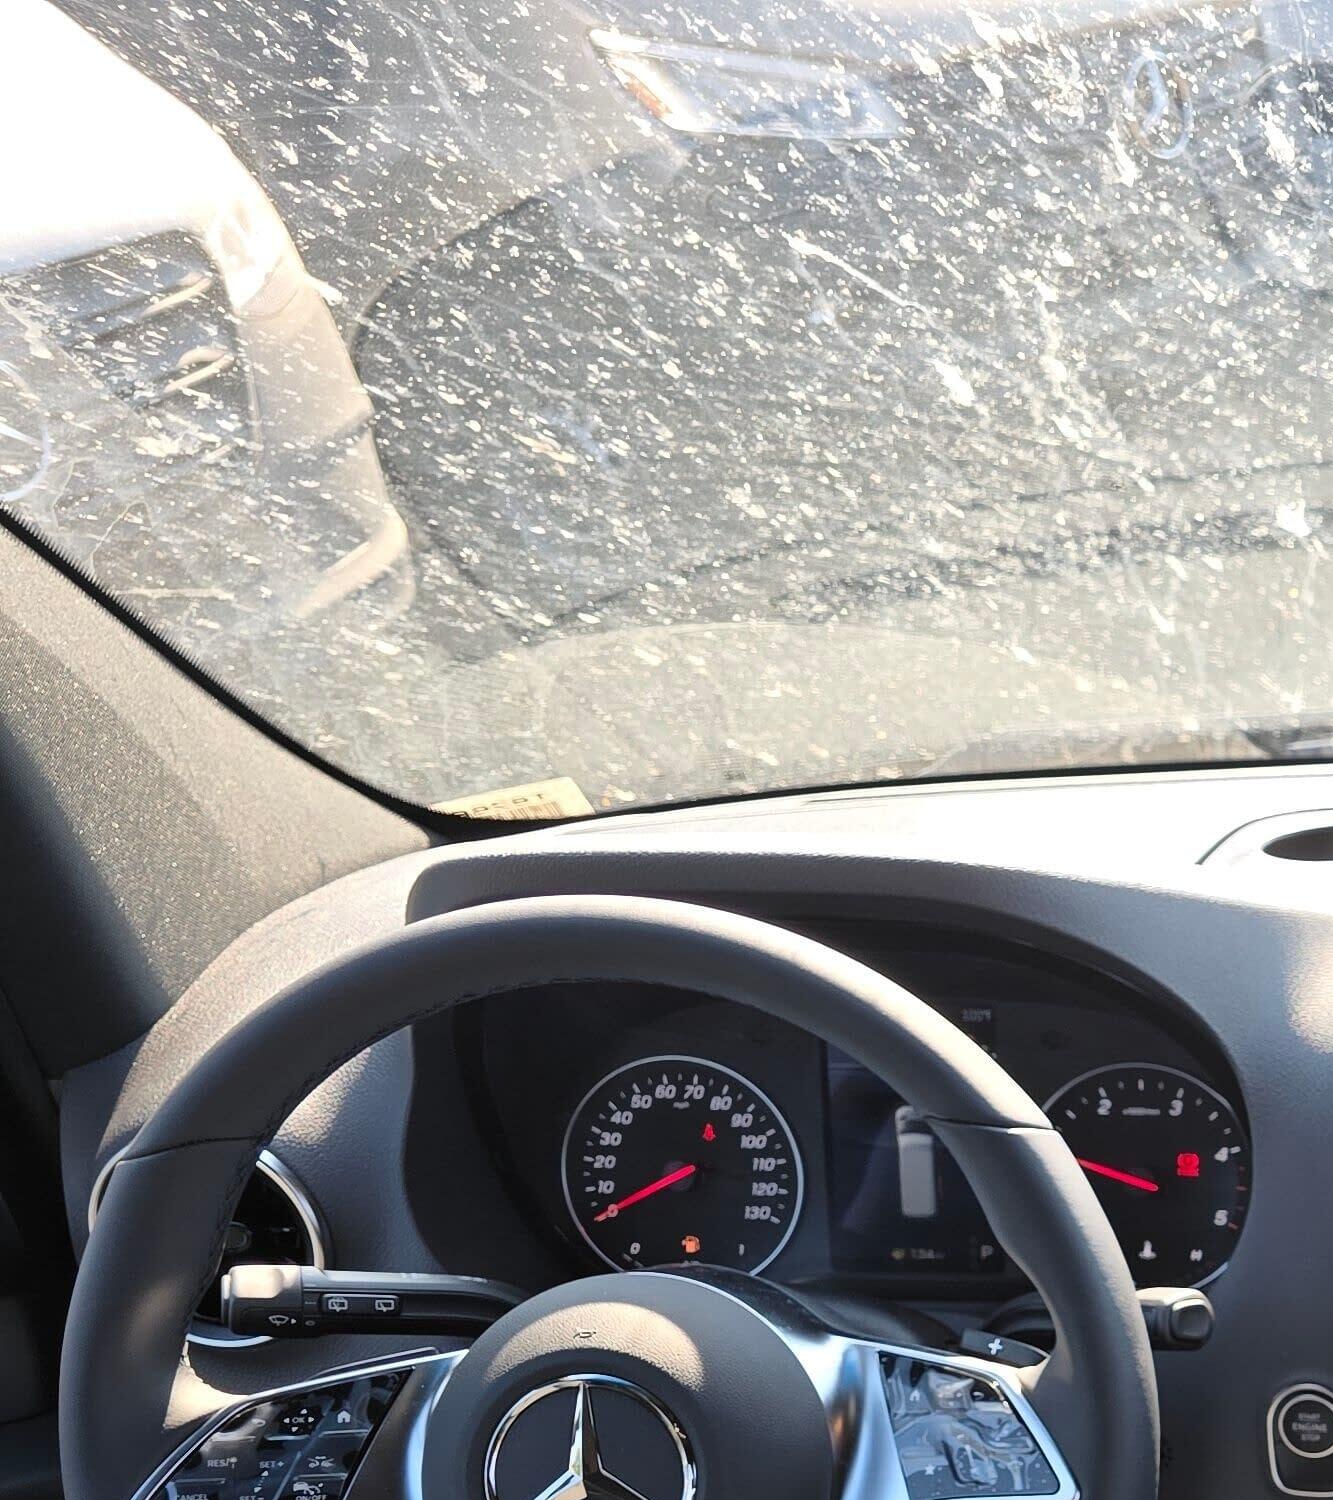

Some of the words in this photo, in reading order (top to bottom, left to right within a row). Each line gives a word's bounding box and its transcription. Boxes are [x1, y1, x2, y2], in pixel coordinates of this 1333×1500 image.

[655, 1084, 677, 1099] 60
[684, 1084, 705, 1099] 70
[631, 1094, 653, 1109] 50
[710, 1096, 732, 1111] 80
[1097, 1098, 1112, 1116] 2
[1168, 1099, 1184, 1117] 3
[610, 1111, 633, 1125] 40
[731, 1113, 753, 1127] 90
[599, 1132, 622, 1146] 30
[740, 1135, 768, 1149] 100
[1214, 1146, 1229, 1162] 4
[594, 1155, 616, 1169] 20
[752, 1157, 776, 1171] 110
[597, 1180, 615, 1195] 10
[751, 1182, 779, 1197] 120
[744, 1205, 772, 1220] 130
[1213, 1209, 1228, 1226] 5
[291, 1416, 305, 1424] OK
